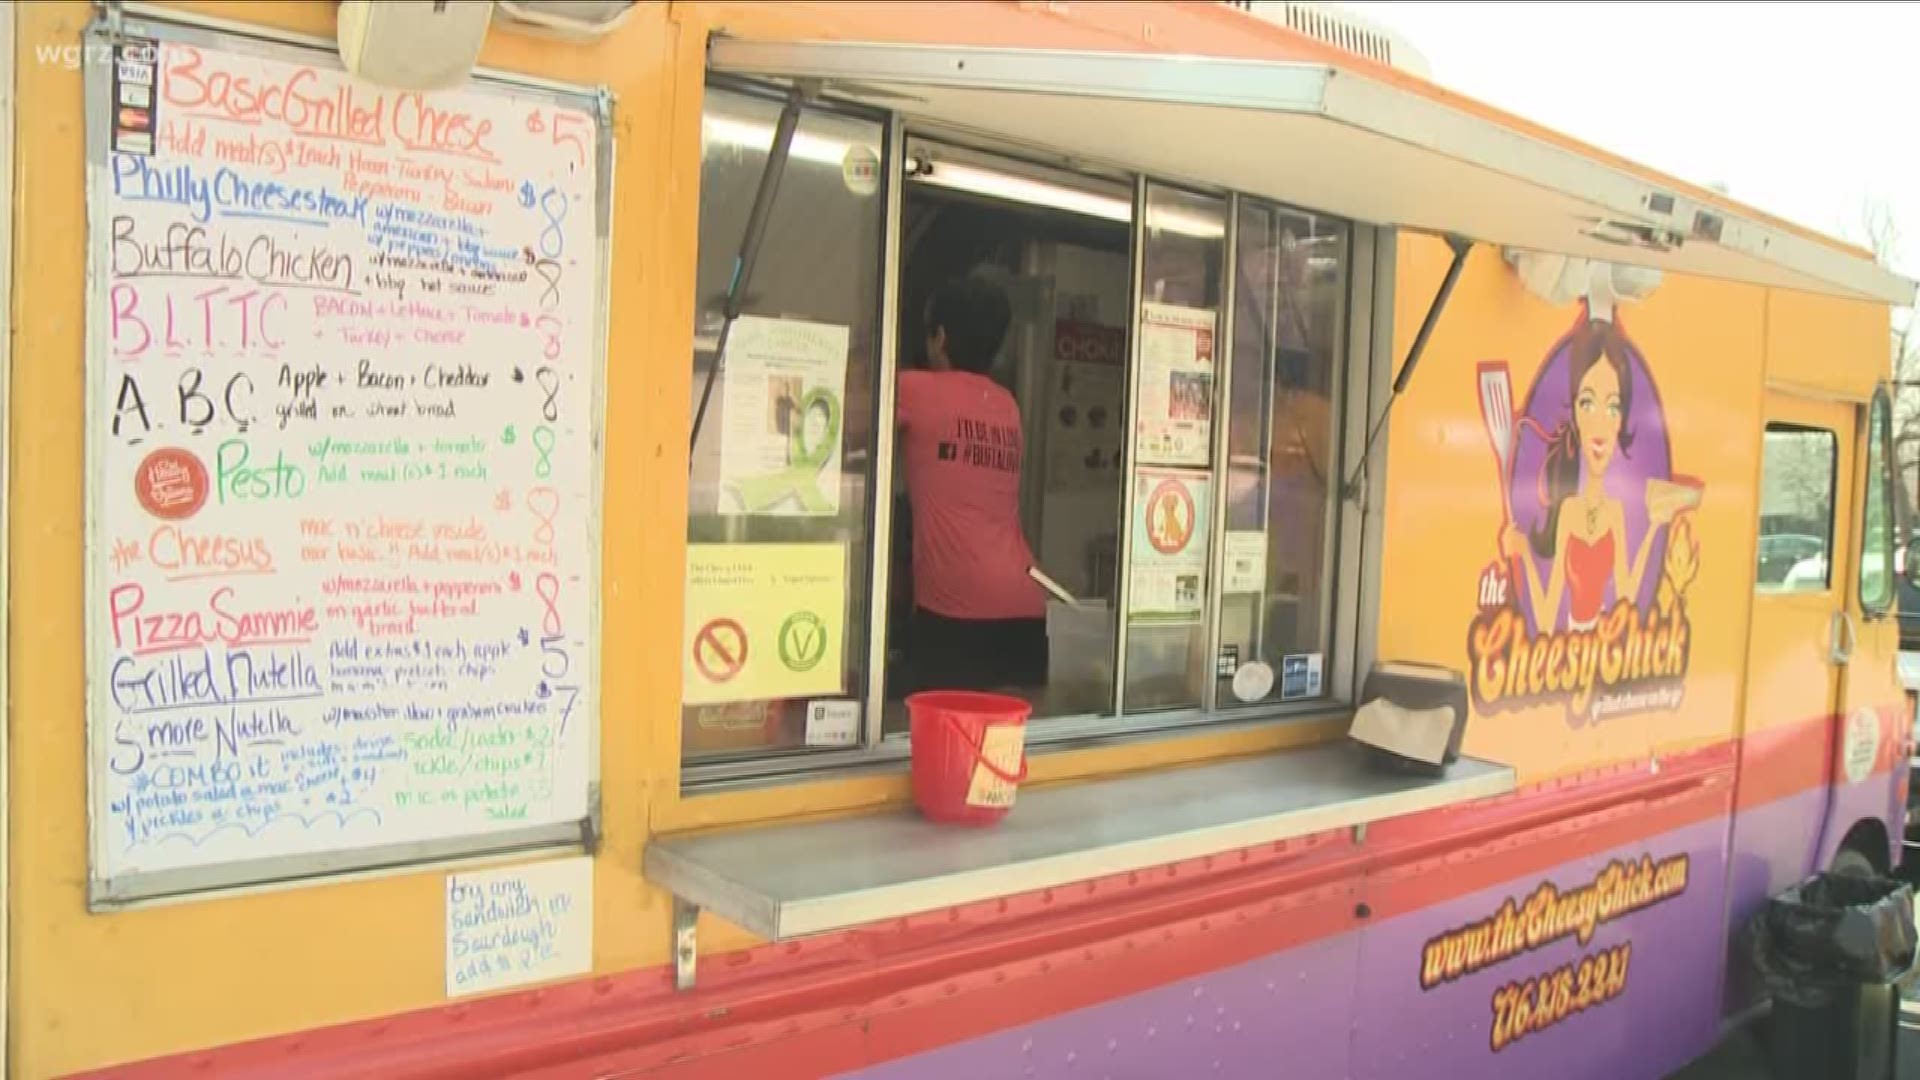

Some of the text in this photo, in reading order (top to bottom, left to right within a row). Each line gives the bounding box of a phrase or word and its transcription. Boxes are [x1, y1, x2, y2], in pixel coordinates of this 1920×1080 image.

[163, 45, 283, 121] Basic
[282, 67, 384, 144] Grilled
[393, 90, 495, 157] Cheese
[157, 121, 206, 157] Add
[112, 155, 212, 223] Philly
[213, 166, 367, 231] Cheesesteak
[112, 215, 243, 276] Buffalo
[245, 234, 355, 289] Chicken
[278, 362, 328, 397] Apple
[357, 359, 404, 388] Bacon
[217, 438, 306, 505] Pesto
[149, 524, 273, 570] Cheesus
[110, 583, 215, 649] Pizza
[210, 587, 318, 645] Sammie
[1479, 568, 1507, 607] the
[111, 649, 224, 714] Grilled
[1473, 597, 1687, 716] Cheesy Chick
[215, 706, 301, 760] Nutella
